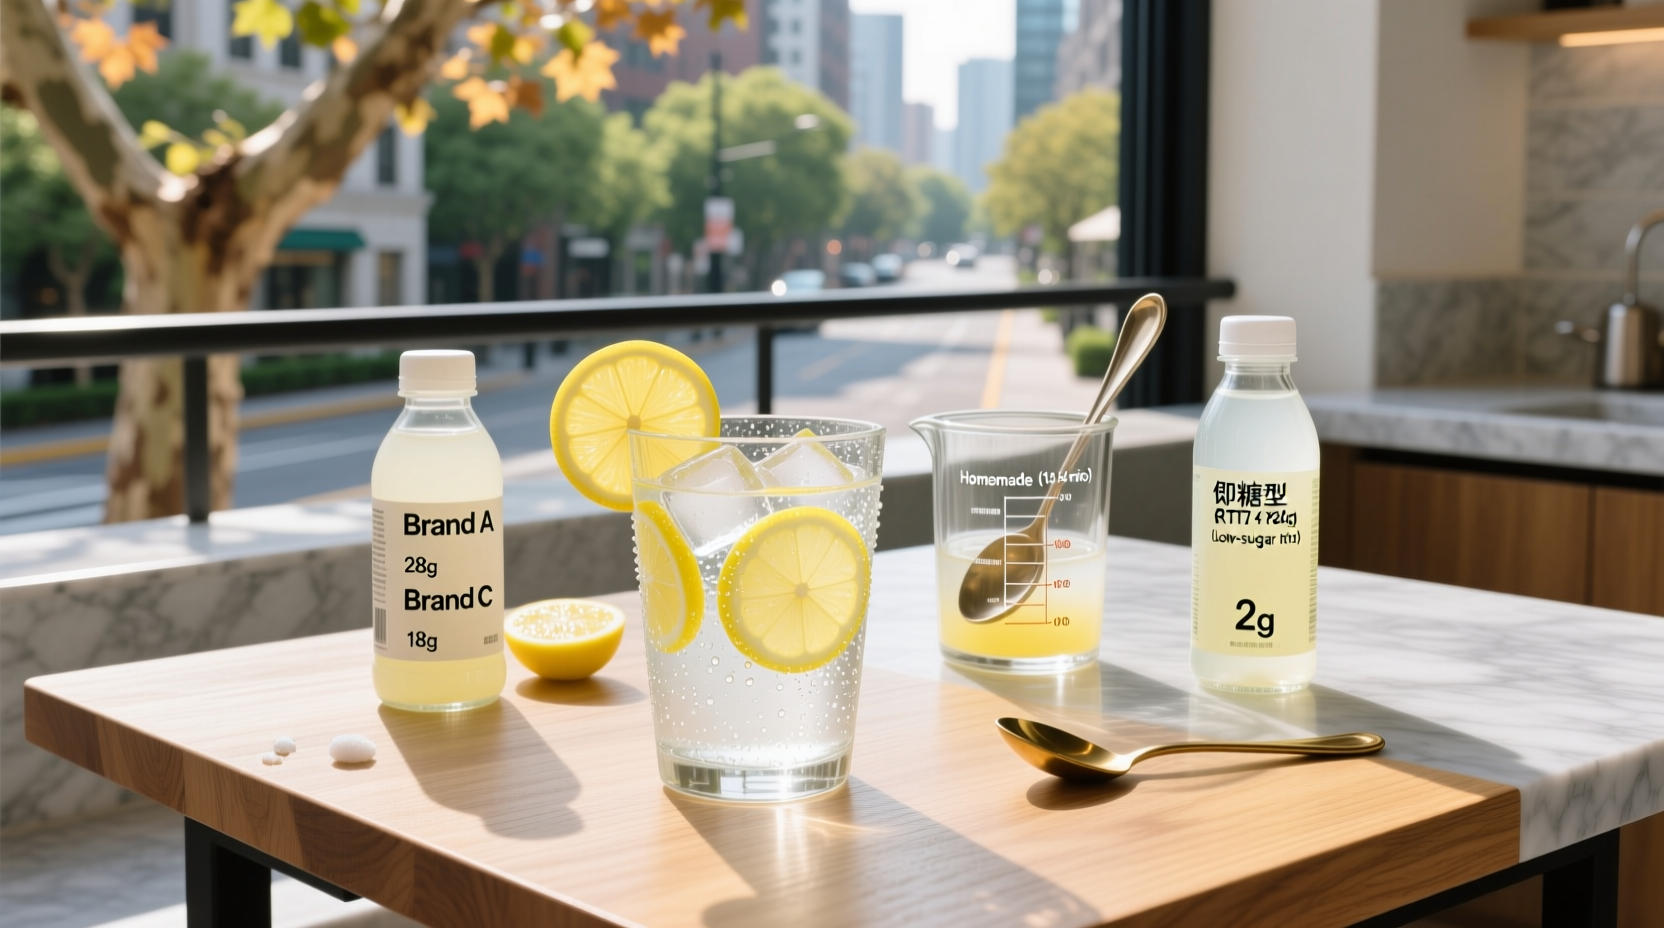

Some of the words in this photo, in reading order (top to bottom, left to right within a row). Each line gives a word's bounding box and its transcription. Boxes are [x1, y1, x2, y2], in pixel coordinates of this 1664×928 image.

[960, 470, 1033, 487] Homemade
[404, 511, 475, 536] Brand
[480, 510, 494, 533] A
[404, 556, 438, 578] 28g
[404, 586, 474, 611] Brand
[478, 585, 493, 607] C
[1235, 598, 1275, 638] 2g
[407, 631, 438, 652] 18g
